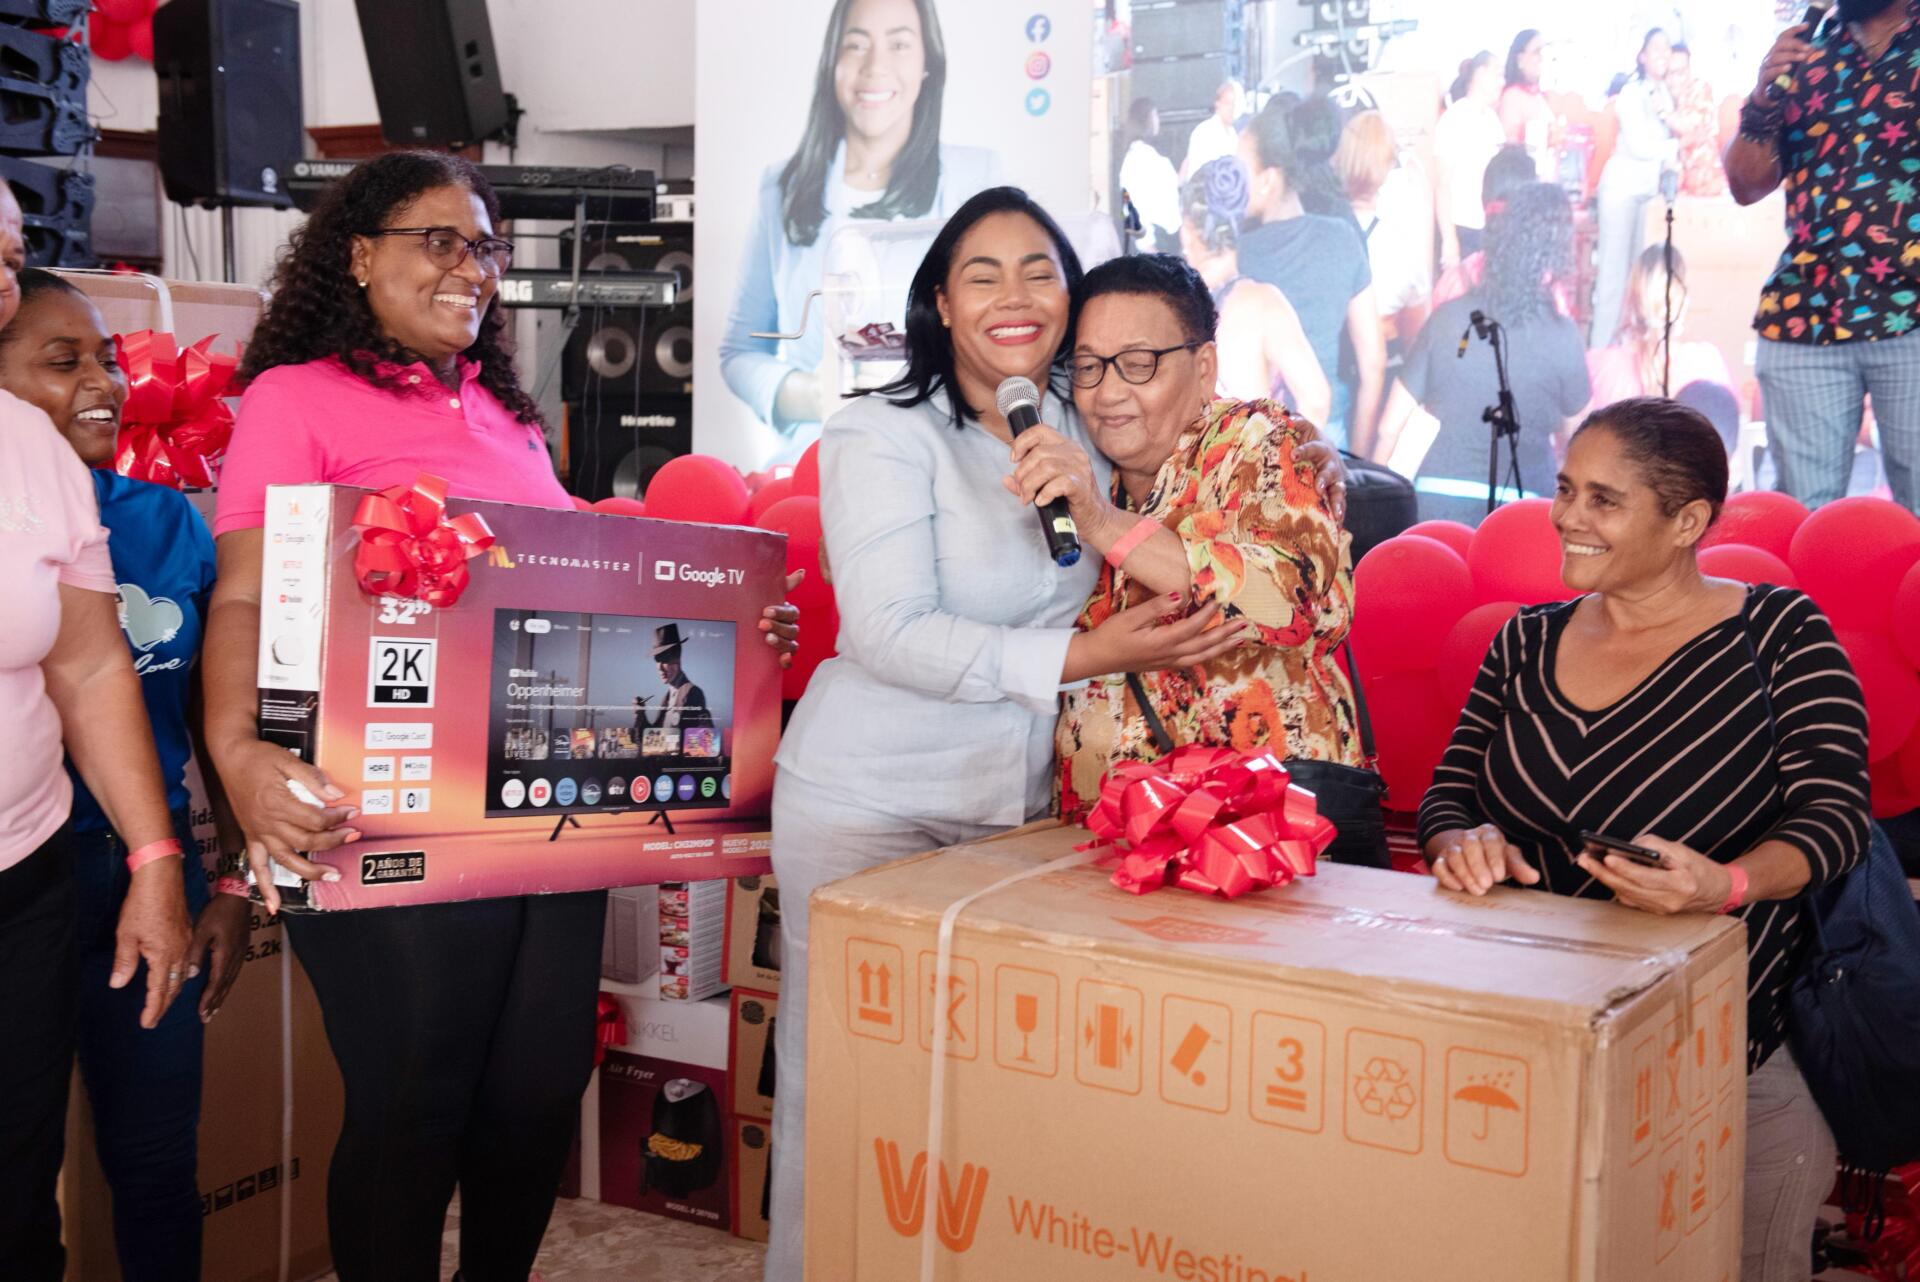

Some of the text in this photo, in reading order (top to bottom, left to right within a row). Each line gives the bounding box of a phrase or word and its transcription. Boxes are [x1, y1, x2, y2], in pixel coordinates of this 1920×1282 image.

[310, 163, 357, 176] YAMAH
[497, 279, 533, 301] RG
[620, 414, 677, 427] Hartke
[679, 563, 745, 588] Google TV
[134, 653, 188, 676] love
[382, 647, 424, 681] 2K
[391, 688, 412, 700] HD
[506, 683, 586, 700] Oppenheimer
[363, 857, 423, 880] 2 AÑOS DE
[1275, 1036, 1305, 1083] 3
[607, 1063, 656, 1080] Air Fryer
[1008, 1195, 1308, 1282] White-Westin
